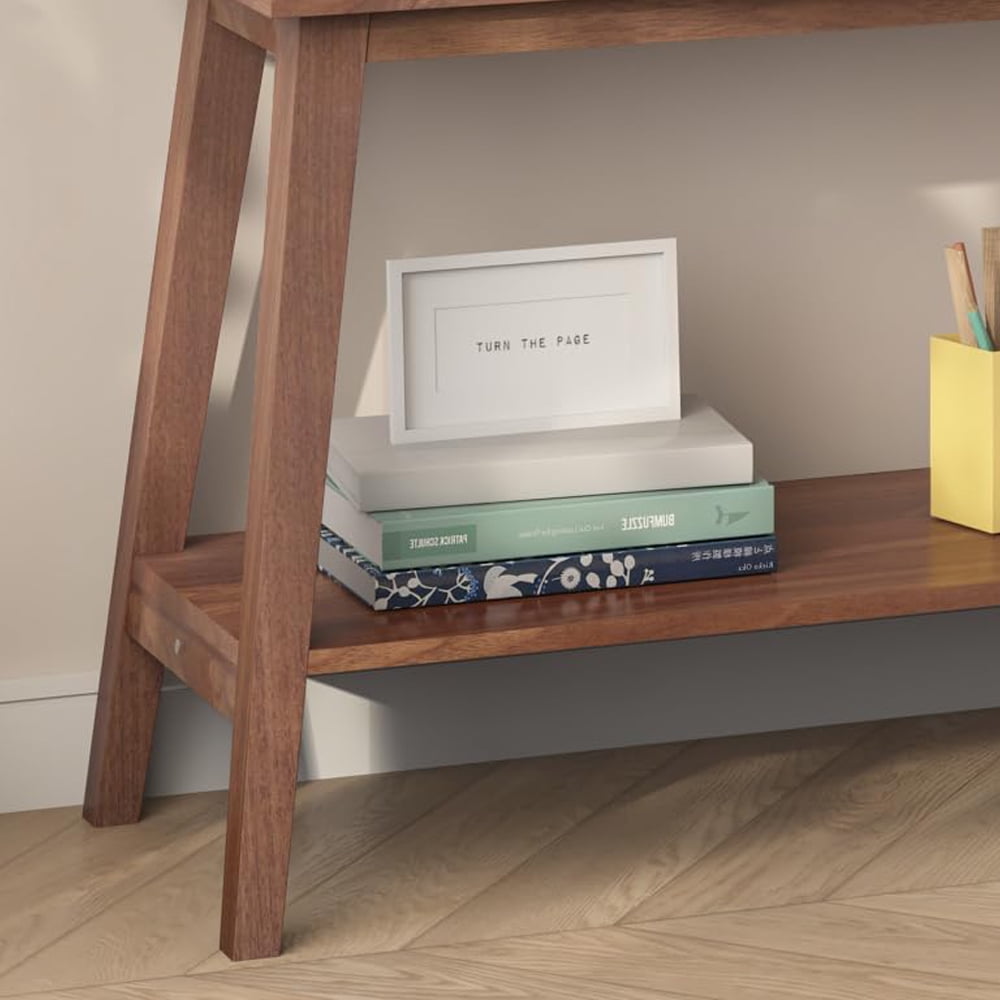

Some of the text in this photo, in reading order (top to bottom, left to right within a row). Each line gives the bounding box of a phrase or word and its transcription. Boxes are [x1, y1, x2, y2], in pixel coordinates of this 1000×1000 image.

[476, 334, 591, 353] TURN THE PAGE
